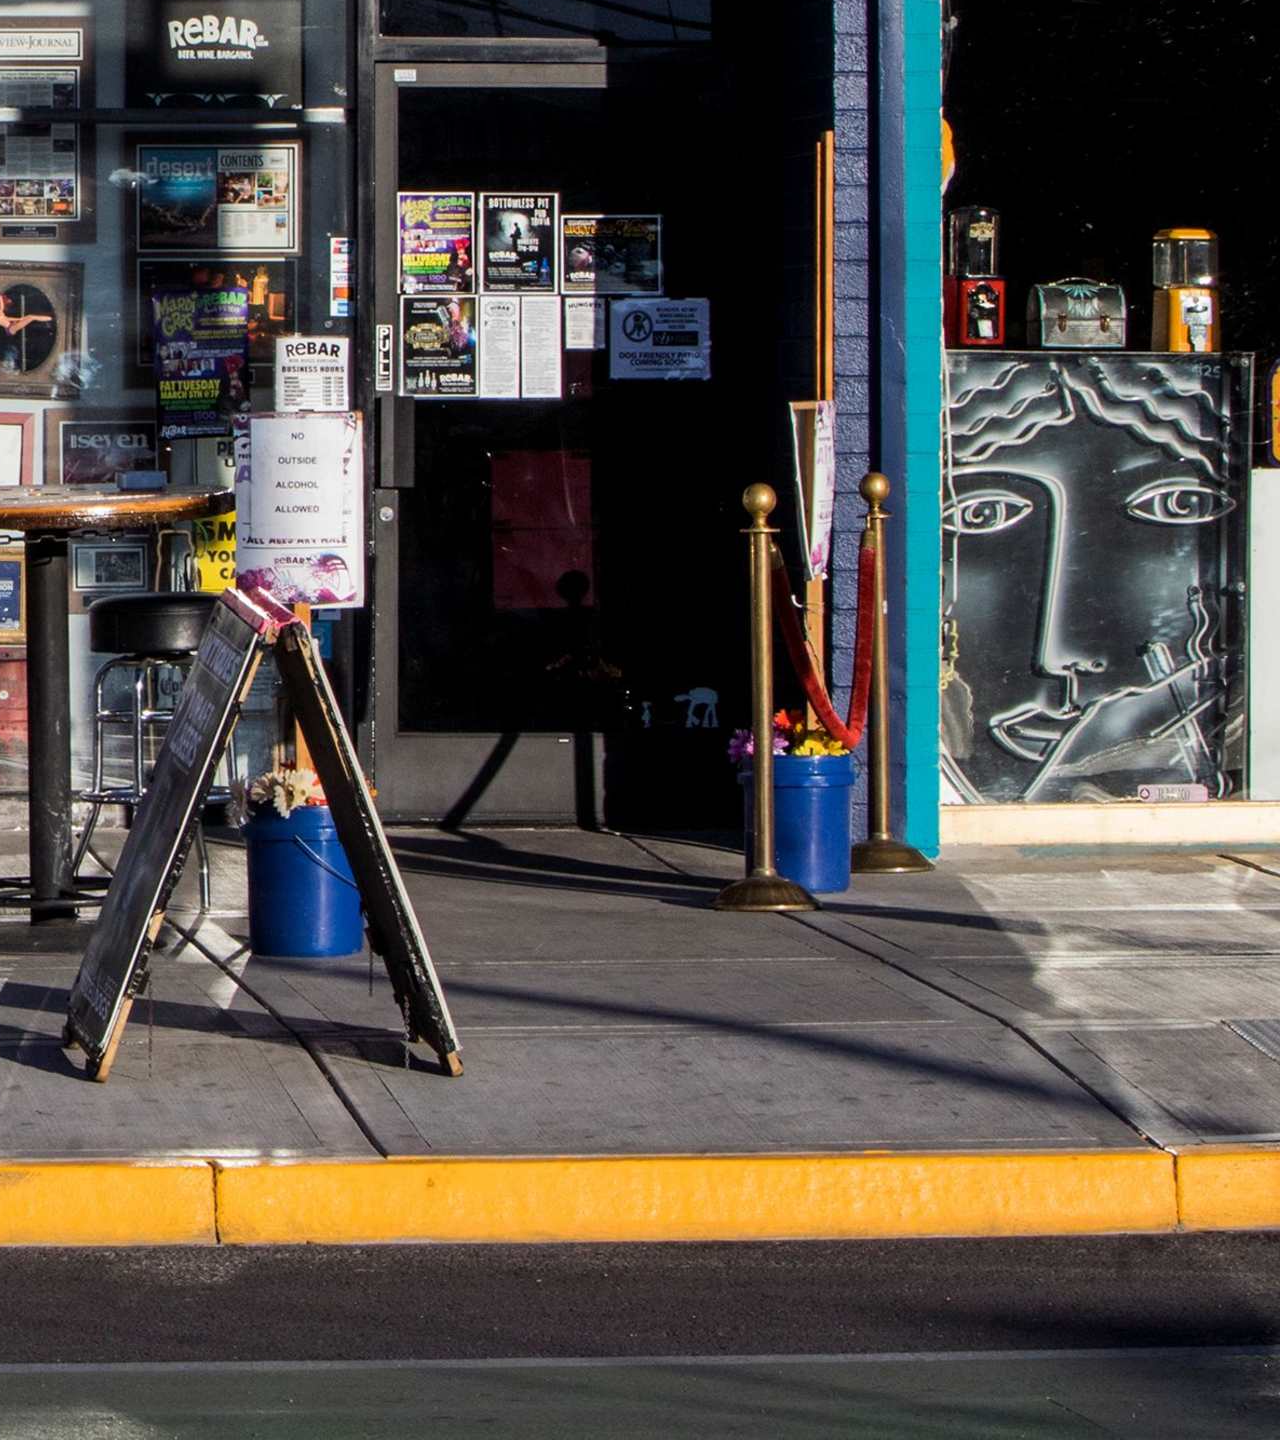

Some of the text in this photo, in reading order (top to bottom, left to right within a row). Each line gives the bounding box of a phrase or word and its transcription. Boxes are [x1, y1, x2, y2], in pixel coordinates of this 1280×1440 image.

[168, 15, 257, 50] ReBAR
[220, 154, 264, 168] CONTENTS
[488, 198, 550, 209] BOTTOMLESS PIT
[285, 342, 341, 358] ReBAR
[378, 326, 391, 376] PULL
[290, 432, 305, 441] NO
[277, 456, 317, 465] OUTSIDE
[275, 480, 319, 490] ALCOHOL
[275, 504, 320, 514] ALLOWED
